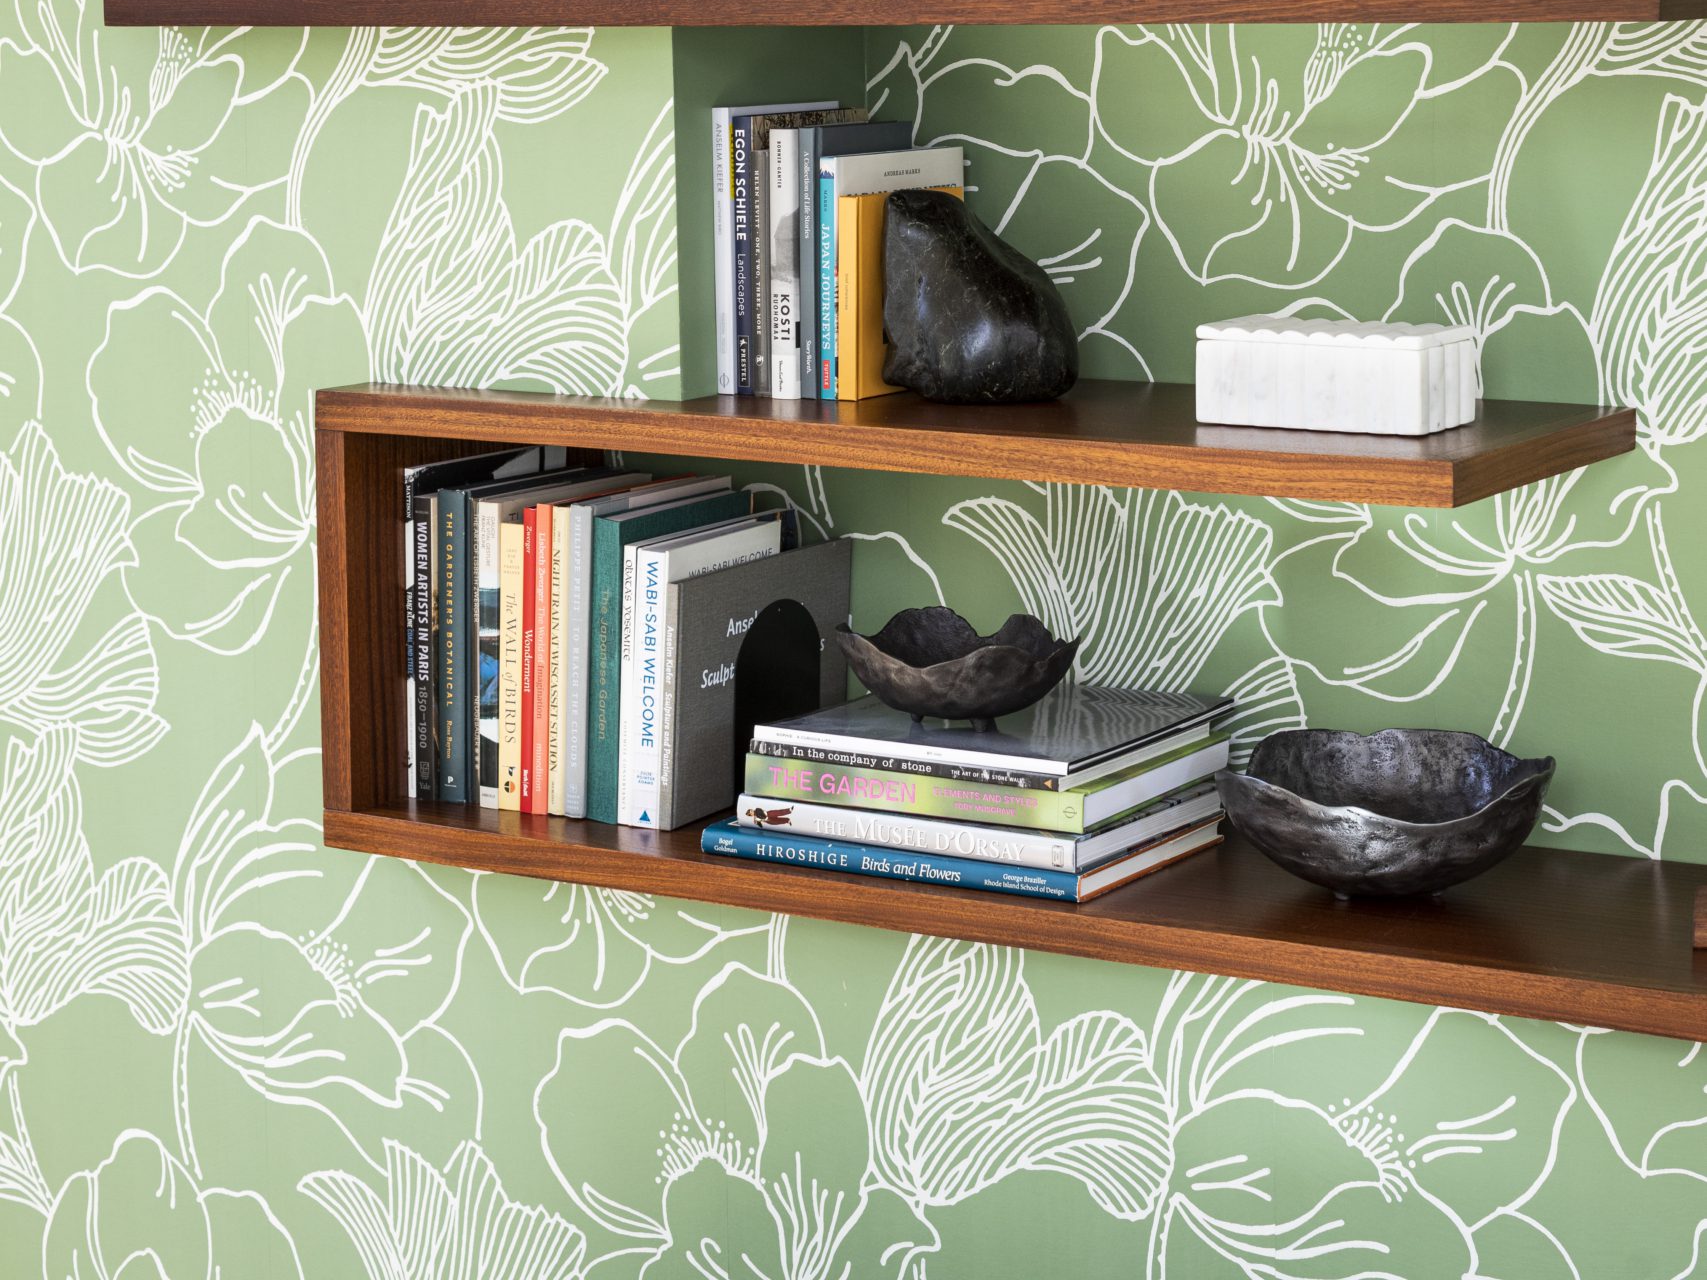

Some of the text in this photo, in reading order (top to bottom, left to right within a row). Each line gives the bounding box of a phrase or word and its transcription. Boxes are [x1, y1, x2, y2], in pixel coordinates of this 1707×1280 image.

[715, 124, 723, 160] ANSELM
[735, 129, 747, 240] EGON SCHIELE
[803, 160, 811, 192] Collection
[804, 192, 811, 200] of
[737, 253, 746, 316] Landscapes
[821, 223, 830, 350] JAPAN JOURNEYS
[781, 294, 790, 341] KOSTI
[416, 522, 428, 569] WOMEN
[524, 525, 533, 555] Zwerger
[552, 549, 561, 589] NIGHT
[417, 573, 429, 624] ARTISTS
[551, 592, 560, 630] TRAIN
[623, 559, 633, 662] OBATA'S YOSEMITE
[418, 628, 429, 641] IN
[535, 532, 546, 719] Lisbeth Zwerger The World of Imagination
[551, 633, 559, 650] AT
[570, 515, 582, 768] PHILIPPE PETIT TO REACH THE CLOUDS
[418, 645, 429, 681] PARIS
[502, 593, 518, 744] The WALL of BIRDS
[524, 630, 533, 693] Wonderment
[598, 588, 610, 740] The Japanese Garden
[641, 561, 659, 748] WABI-SABI WELCOME
[550, 652, 559, 719] WISCASSET
[661, 625, 674, 786] Anselm Kiefer Sculpture and Paintings
[550, 722, 558, 772] STATION
[792, 746, 932, 773] In the company of stone
[535, 743, 543, 792] minedition
[769, 767, 916, 805] THE GARDEN
[951, 769, 960, 777] THE
[961, 770, 971, 778] ART
[972, 771, 979, 779] OF
[991, 774, 1008, 783] STONE
[932, 787, 1038, 809] ELEMENTS AND STYLES
[718, 837, 734, 847] Bogel
[814, 818, 848, 838] THE
[713, 845, 738, 854] Goldman
[756, 843, 961, 882] HIROSHIGE Birds and Flowers
[984, 879, 1066, 896] Rhode Island School of Design
[1002, 873, 1047, 885] George Braziller
